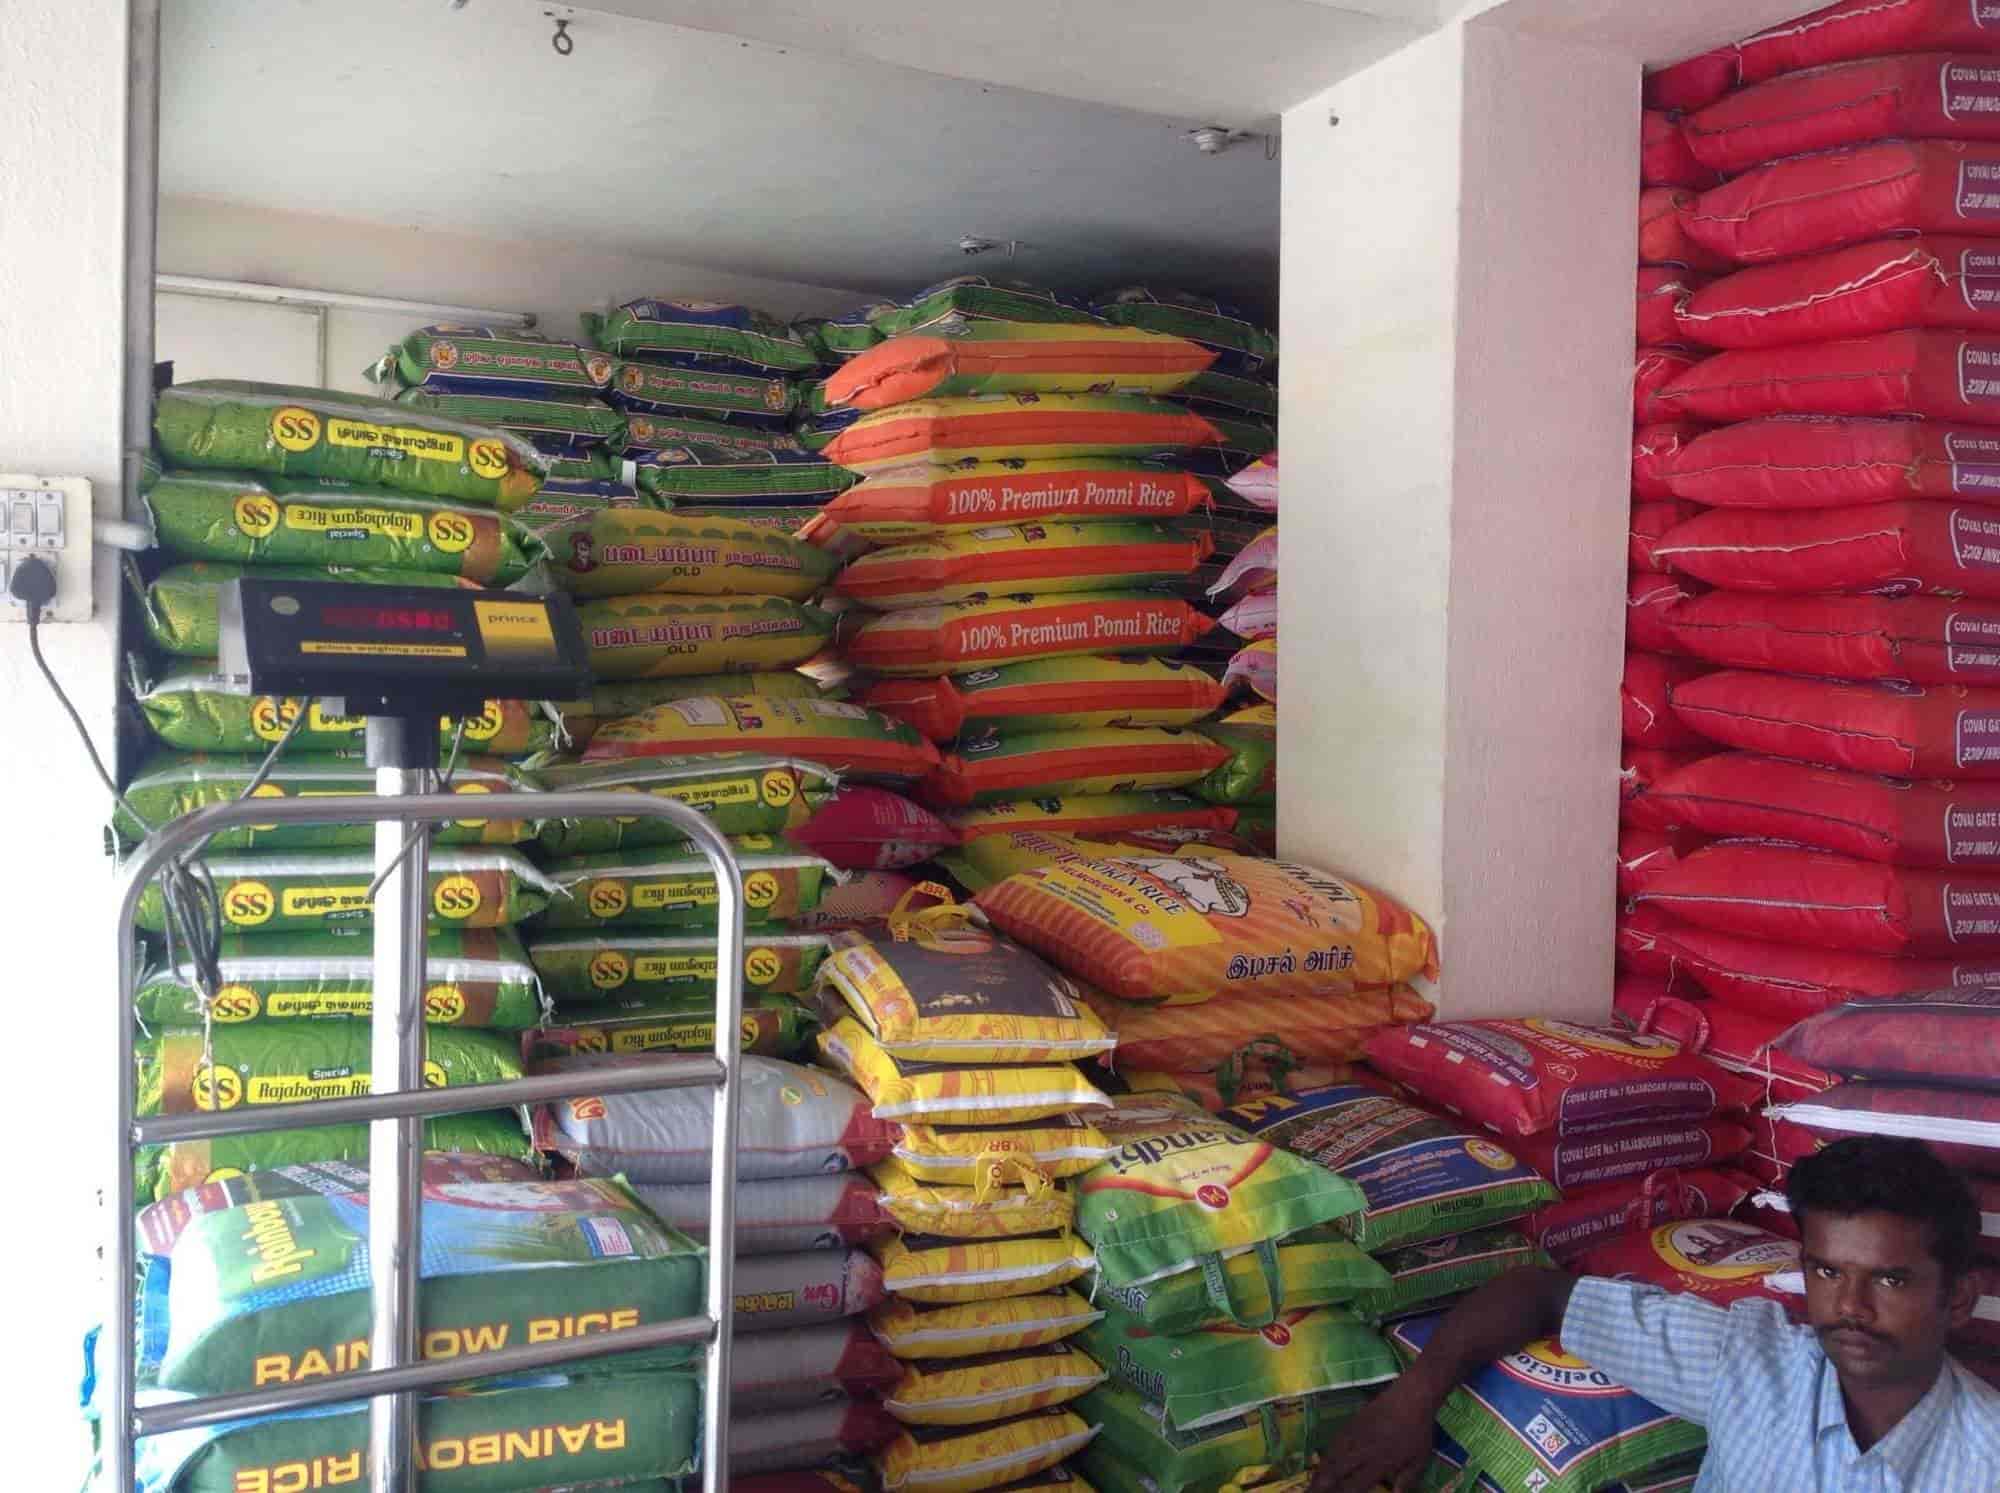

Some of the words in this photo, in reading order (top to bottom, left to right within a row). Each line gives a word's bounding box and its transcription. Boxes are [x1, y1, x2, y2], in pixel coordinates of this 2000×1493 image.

[1951, 68, 1978, 81] COVAI
[1968, 167, 1990, 179] COVAI
[1970, 256, 1994, 267] COVAI
[1966, 351, 1990, 365] COVAI
[280, 415, 315, 442] SS
[1952, 440, 1977, 450] COVAI
[475, 443, 511, 470] SS
[946, 487, 996, 515] 100%
[1083, 481, 1132, 506] Ponni
[1137, 482, 1177, 507] Rice
[242, 503, 273, 529] SS
[295, 509, 328, 527] Rice
[332, 510, 413, 534] Rajabogam
[432, 519, 467, 542] SS
[1958, 518, 1981, 533] COVAI
[671, 566, 701, 577] OLD
[486, 613, 539, 625] prince
[1954, 621, 1980, 633] COVAI
[960, 624, 1007, 653] 100%
[1010, 615, 1089, 647] Premium
[1092, 611, 1142, 638] Ponni
[1144, 611, 1182, 637] Rice
[666, 644, 698, 655] OLD
[1963, 719, 1986, 733] COVAI
[766, 779, 791, 799] SS
[1952, 812, 1974, 828] COVAI
[1975, 812, 1996, 828] GATE
[440, 886, 471, 909] SS
[594, 888, 622, 910] SS
[749, 881, 774, 900] SS
[1137, 883, 1186, 916] RICE
[1951, 893, 1972, 906] COVAI
[231, 892, 267, 916] SS
[595, 962, 624, 980] SS
[750, 956, 776, 974] SS
[214, 999, 249, 1017] SS
[313, 1067, 351, 1078] Special
[258, 1082, 346, 1102] Rajabogam
[1566, 1092, 1586, 1104] COVAI
[1589, 1089, 1608, 1099] GATE
[1561, 1149, 1583, 1163] COVAI
[1584, 1145, 1602, 1159] GATE
[1547, 1230, 1570, 1248] COVAI
[1570, 1223, 1591, 1239] GATE
[234, 1449, 363, 1493] RICE
